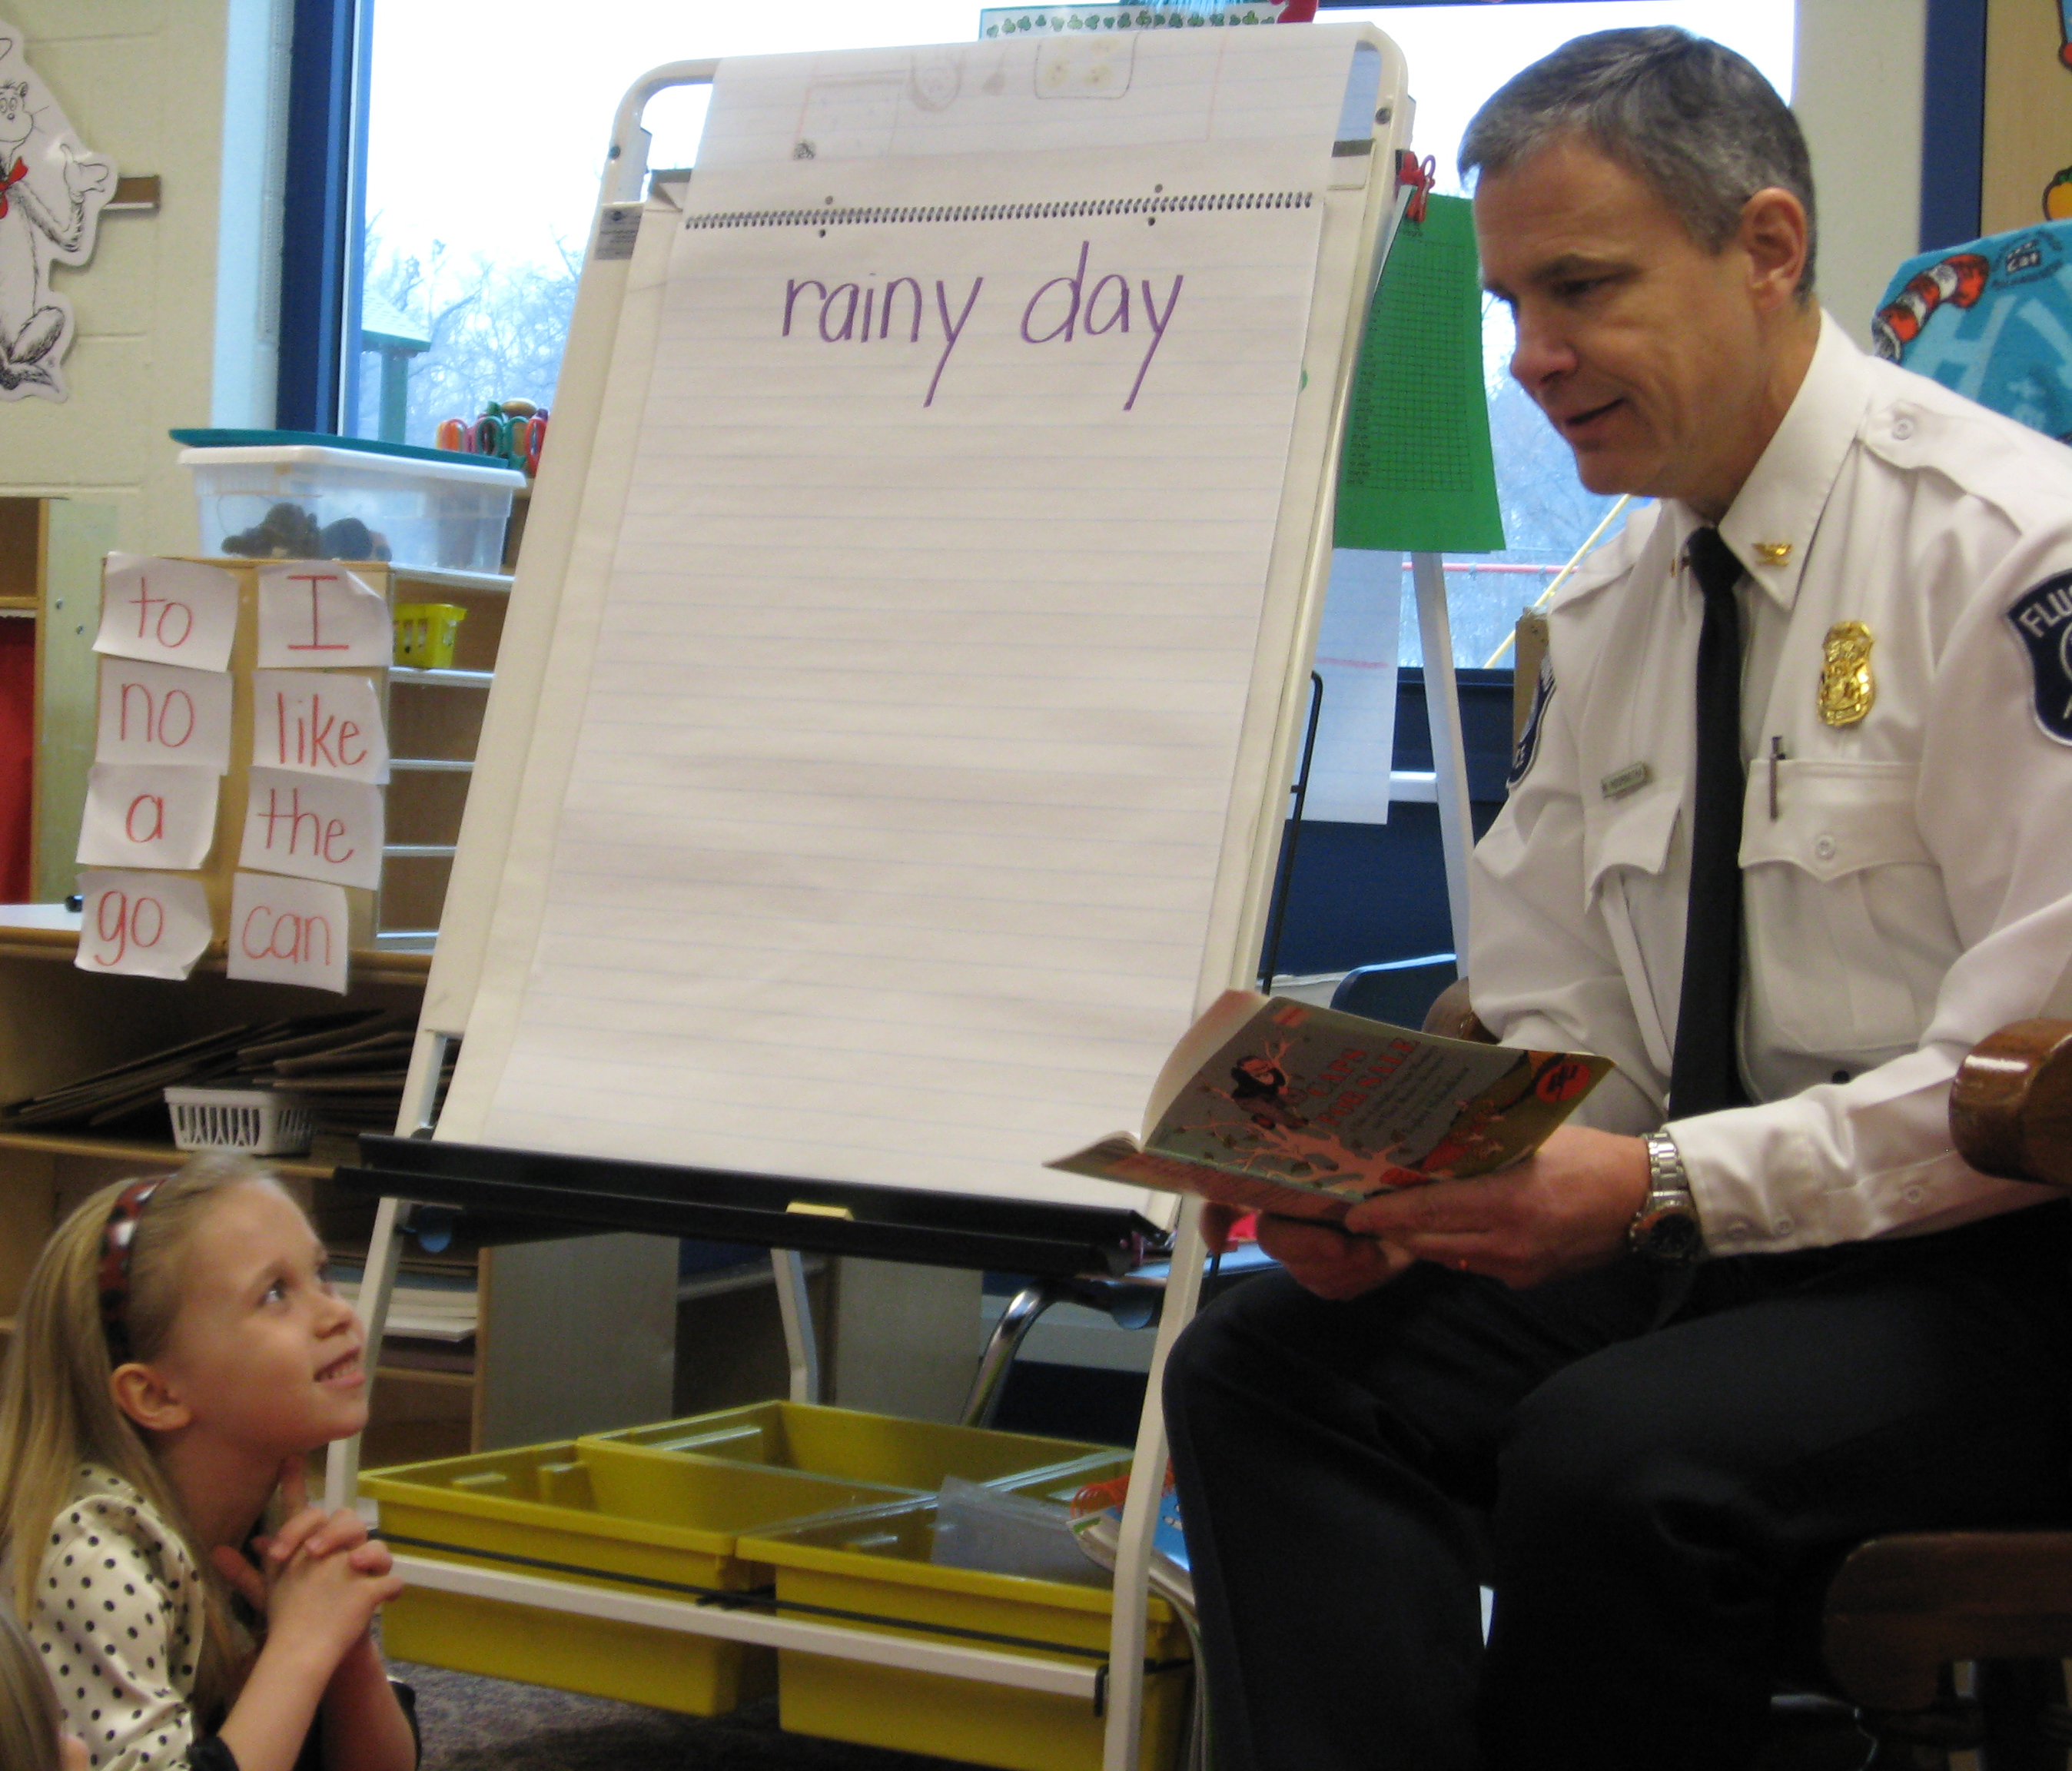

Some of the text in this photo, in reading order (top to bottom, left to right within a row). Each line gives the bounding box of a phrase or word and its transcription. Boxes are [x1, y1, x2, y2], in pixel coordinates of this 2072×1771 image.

[782, 274, 983, 407] rainy
[1021, 241, 1184, 411] day
[130, 576, 194, 649] to
[287, 574, 350, 651] I
[2018, 583, 2072, 639] FLU
[120, 683, 197, 748] no
[277, 692, 367, 767] like
[125, 793, 164, 843] a
[256, 787, 354, 864] the
[94, 889, 165, 966] go
[242, 905, 330, 965] can
[1307, 1047, 1368, 1098] CAPS
